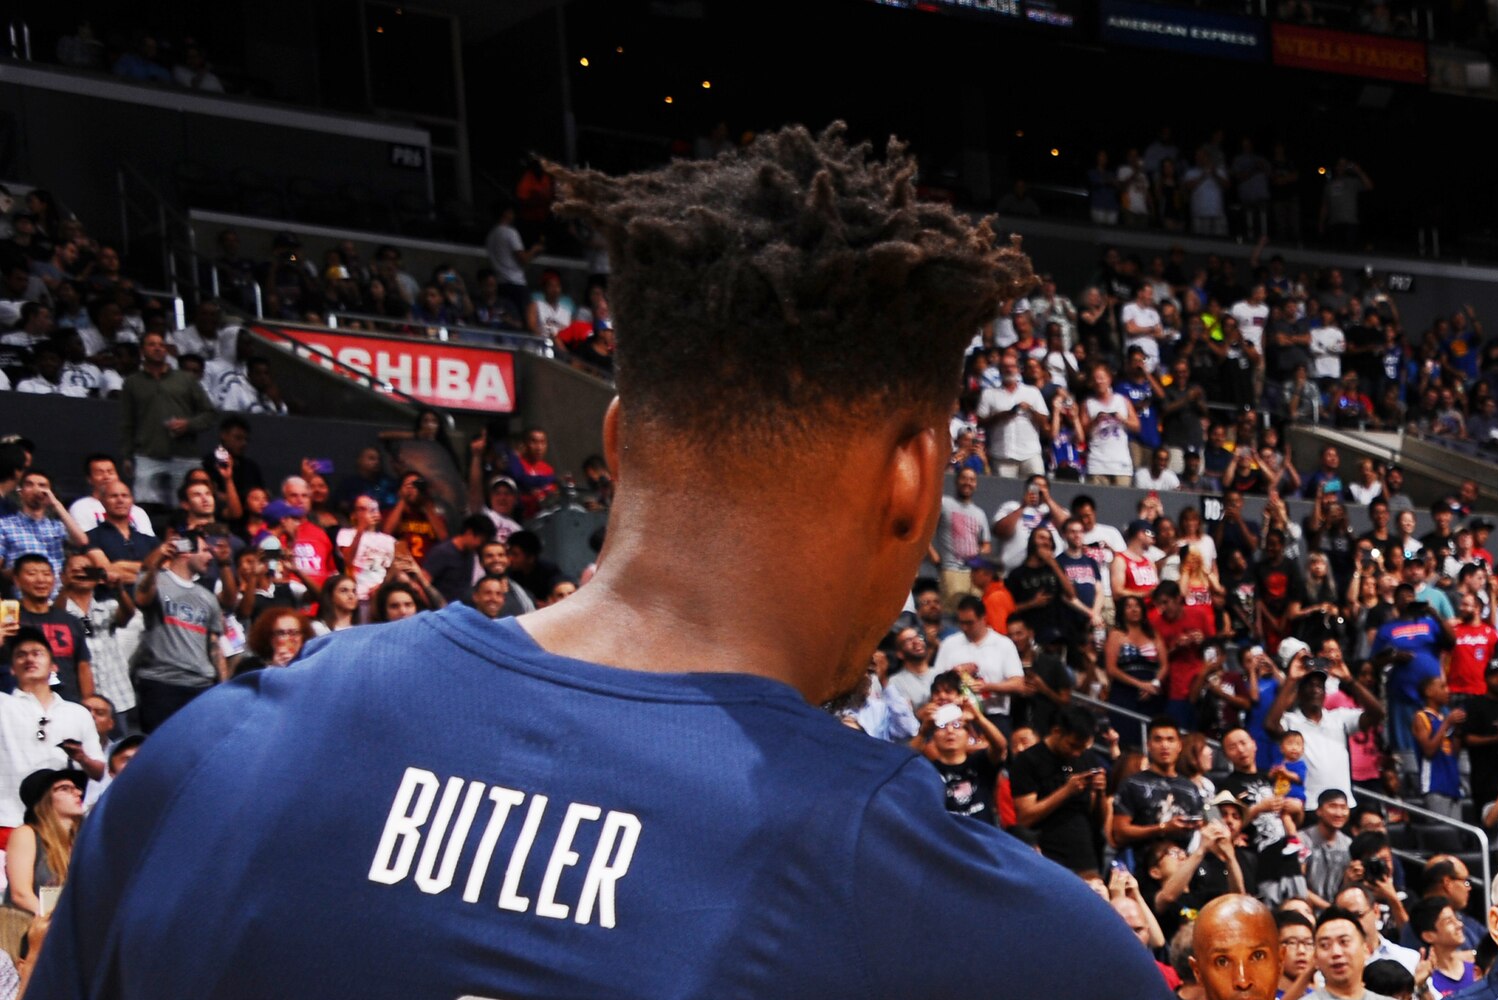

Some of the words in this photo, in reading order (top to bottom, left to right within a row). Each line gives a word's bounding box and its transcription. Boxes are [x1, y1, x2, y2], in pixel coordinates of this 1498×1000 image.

[1108, 17, 1187, 38] AMERICAN
[1189, 26, 1258, 46] EXPRESS
[1277, 36, 1350, 62] WELLS
[1355, 48, 1423, 71] FARGO
[270, 338, 510, 404] SHIBA
[368, 766, 642, 929] BUTLER
